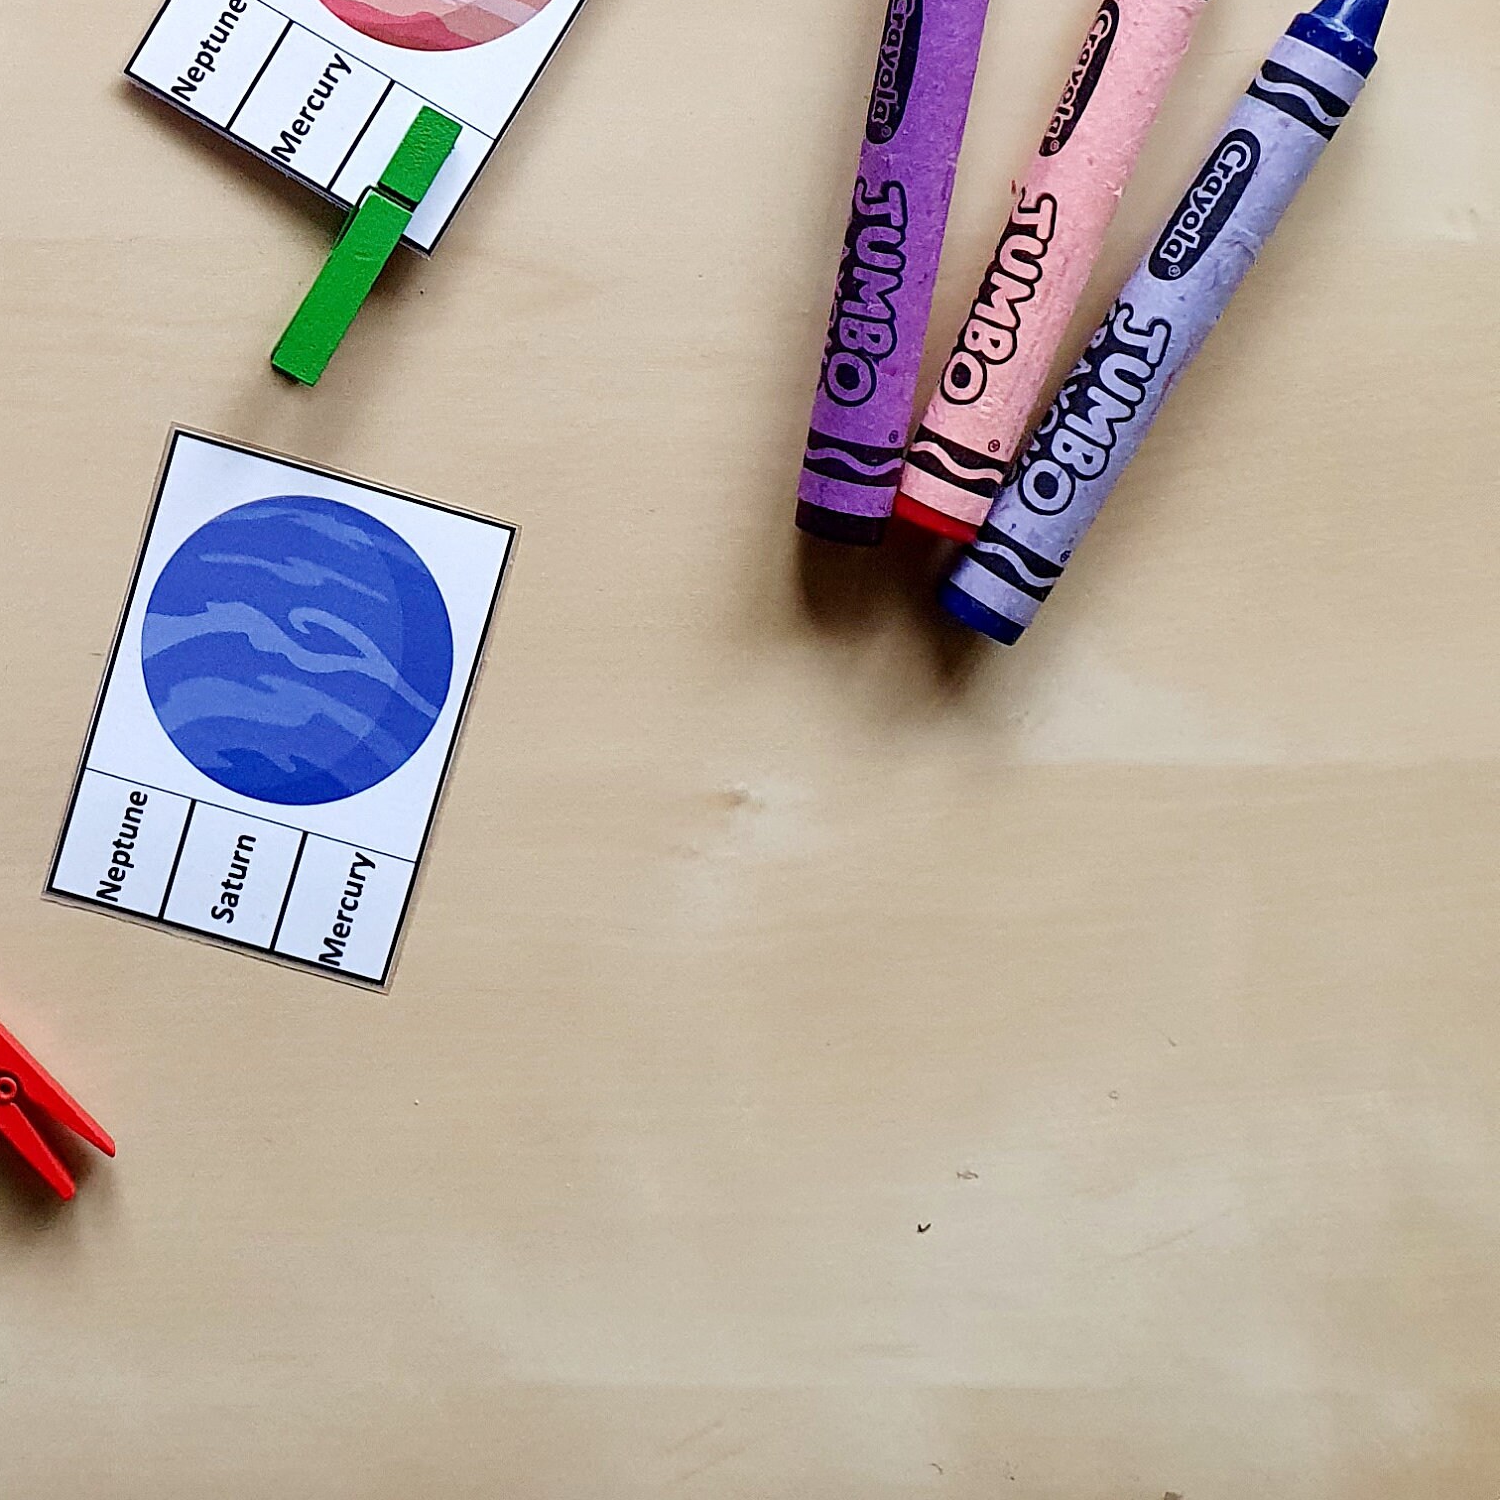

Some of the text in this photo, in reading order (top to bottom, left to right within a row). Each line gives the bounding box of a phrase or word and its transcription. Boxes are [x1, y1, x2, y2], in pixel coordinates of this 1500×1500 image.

[270, 52, 352, 163] Mercury
[1159, 140, 1252, 263] Crayola
[824, 177, 908, 406] JUMBO
[941, 192, 1057, 405] JUMBO
[1019, 302, 1172, 515] JUMBO
[96, 789, 148, 902] Neptune
[210, 833, 257, 924] Saturn
[318, 851, 376, 967] Mercury
